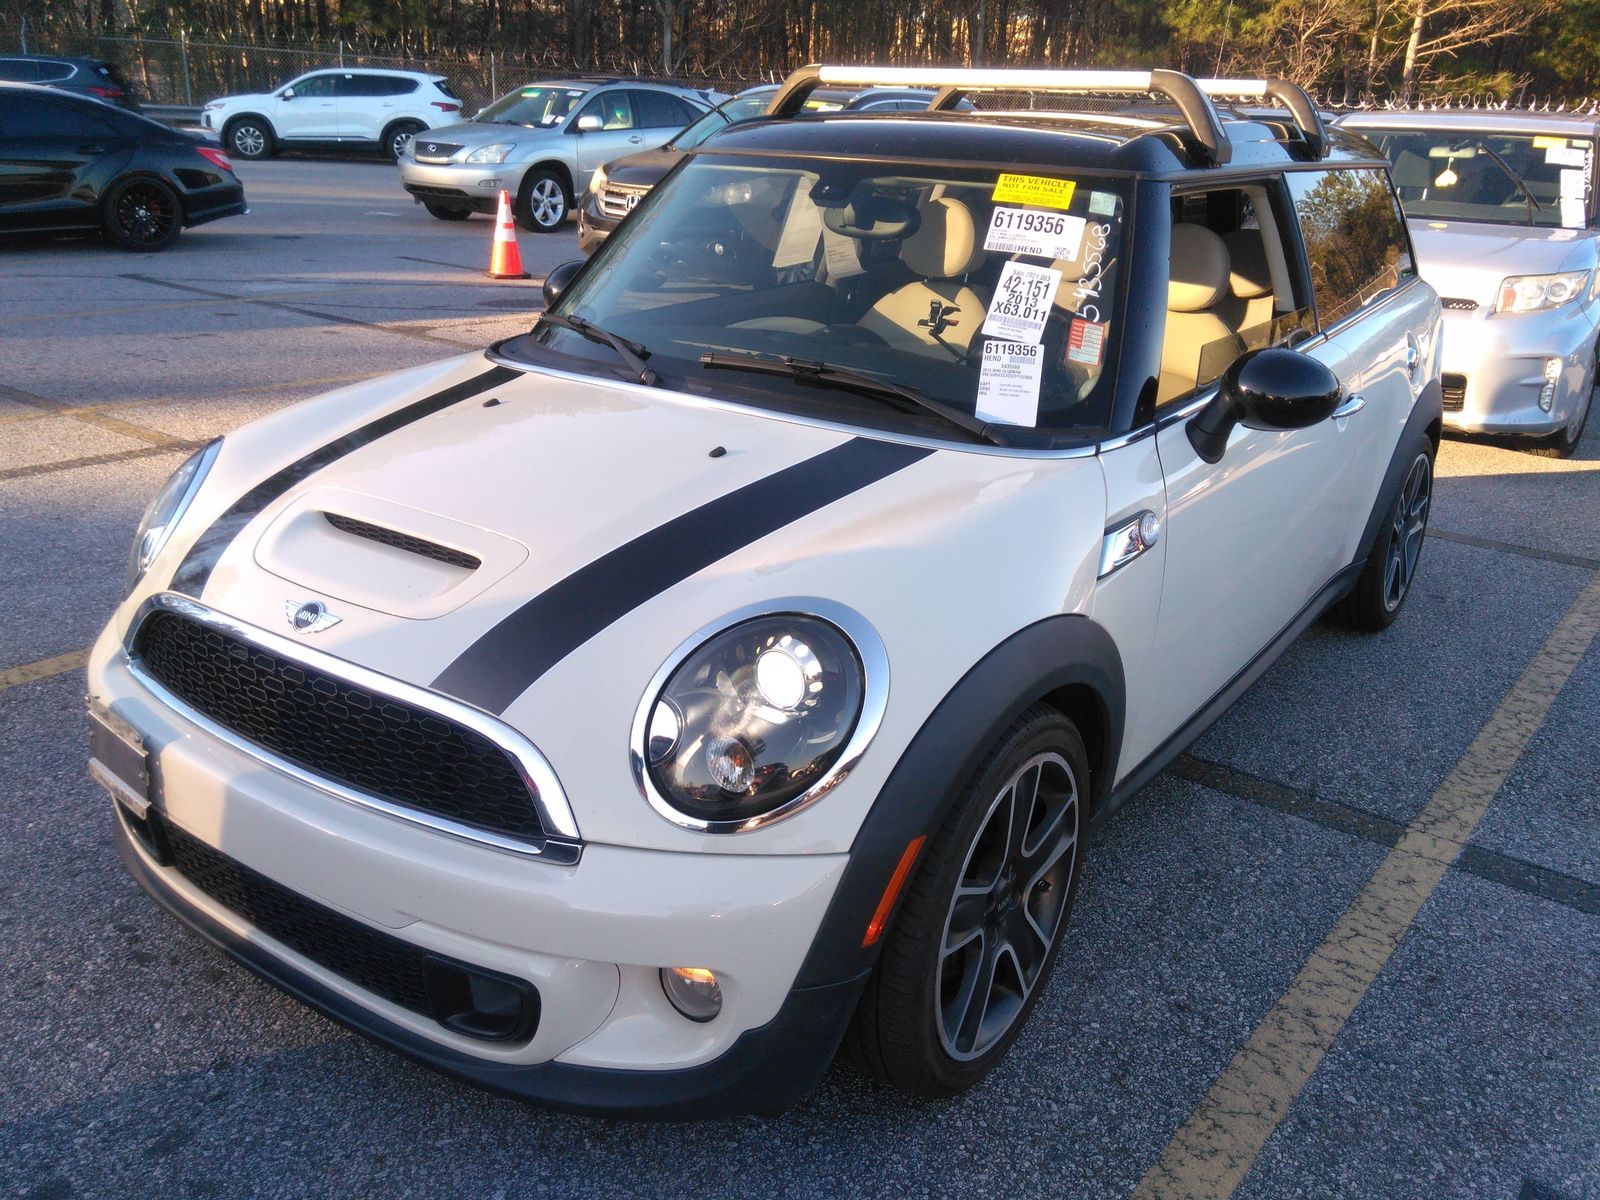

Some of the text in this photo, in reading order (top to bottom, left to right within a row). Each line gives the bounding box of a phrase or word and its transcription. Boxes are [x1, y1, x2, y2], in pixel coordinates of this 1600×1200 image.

[1003, 175, 1069, 189] THIS VEHICLE
[1022, 184, 1040, 192] FOR
[1043, 186, 1065, 195] SALE
[994, 210, 1065, 235] 6119356
[1017, 245, 1042, 255] HEND
[1026, 271, 1039, 280] 2021
[1003, 275, 1051, 300] 42:151
[1006, 293, 1038, 308] 2013
[993, 301, 1047, 322] X63,011
[985, 342, 1037, 357] 6119356
[984, 354, 1002, 362] HEND
[299, 610, 317, 623] MINI
